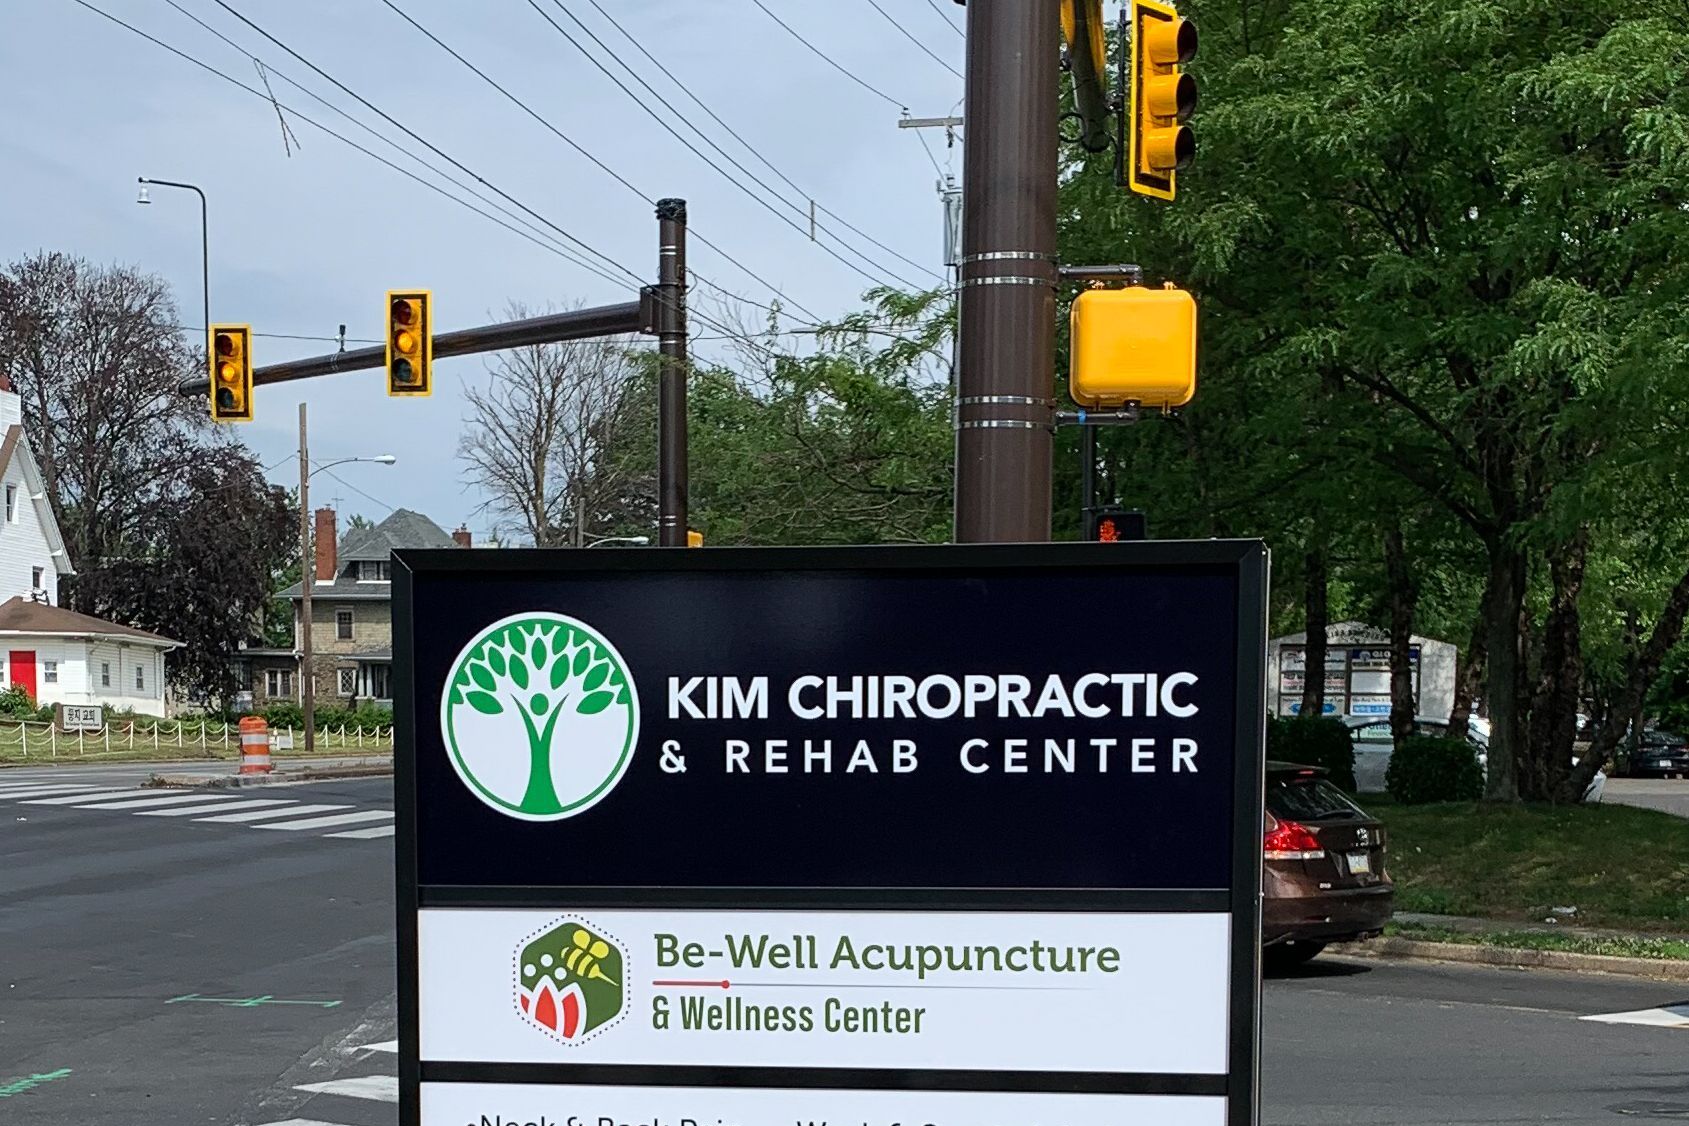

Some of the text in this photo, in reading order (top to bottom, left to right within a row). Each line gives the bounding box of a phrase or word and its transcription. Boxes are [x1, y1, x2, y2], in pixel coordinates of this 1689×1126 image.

[668, 671, 1199, 720] KIM CHIROPRACTIC
[659, 738, 1198, 774] & REHAB CENTER
[653, 933, 1121, 980] Be-Well Acupuncture
[652, 995, 926, 1034] & Wellness Center
